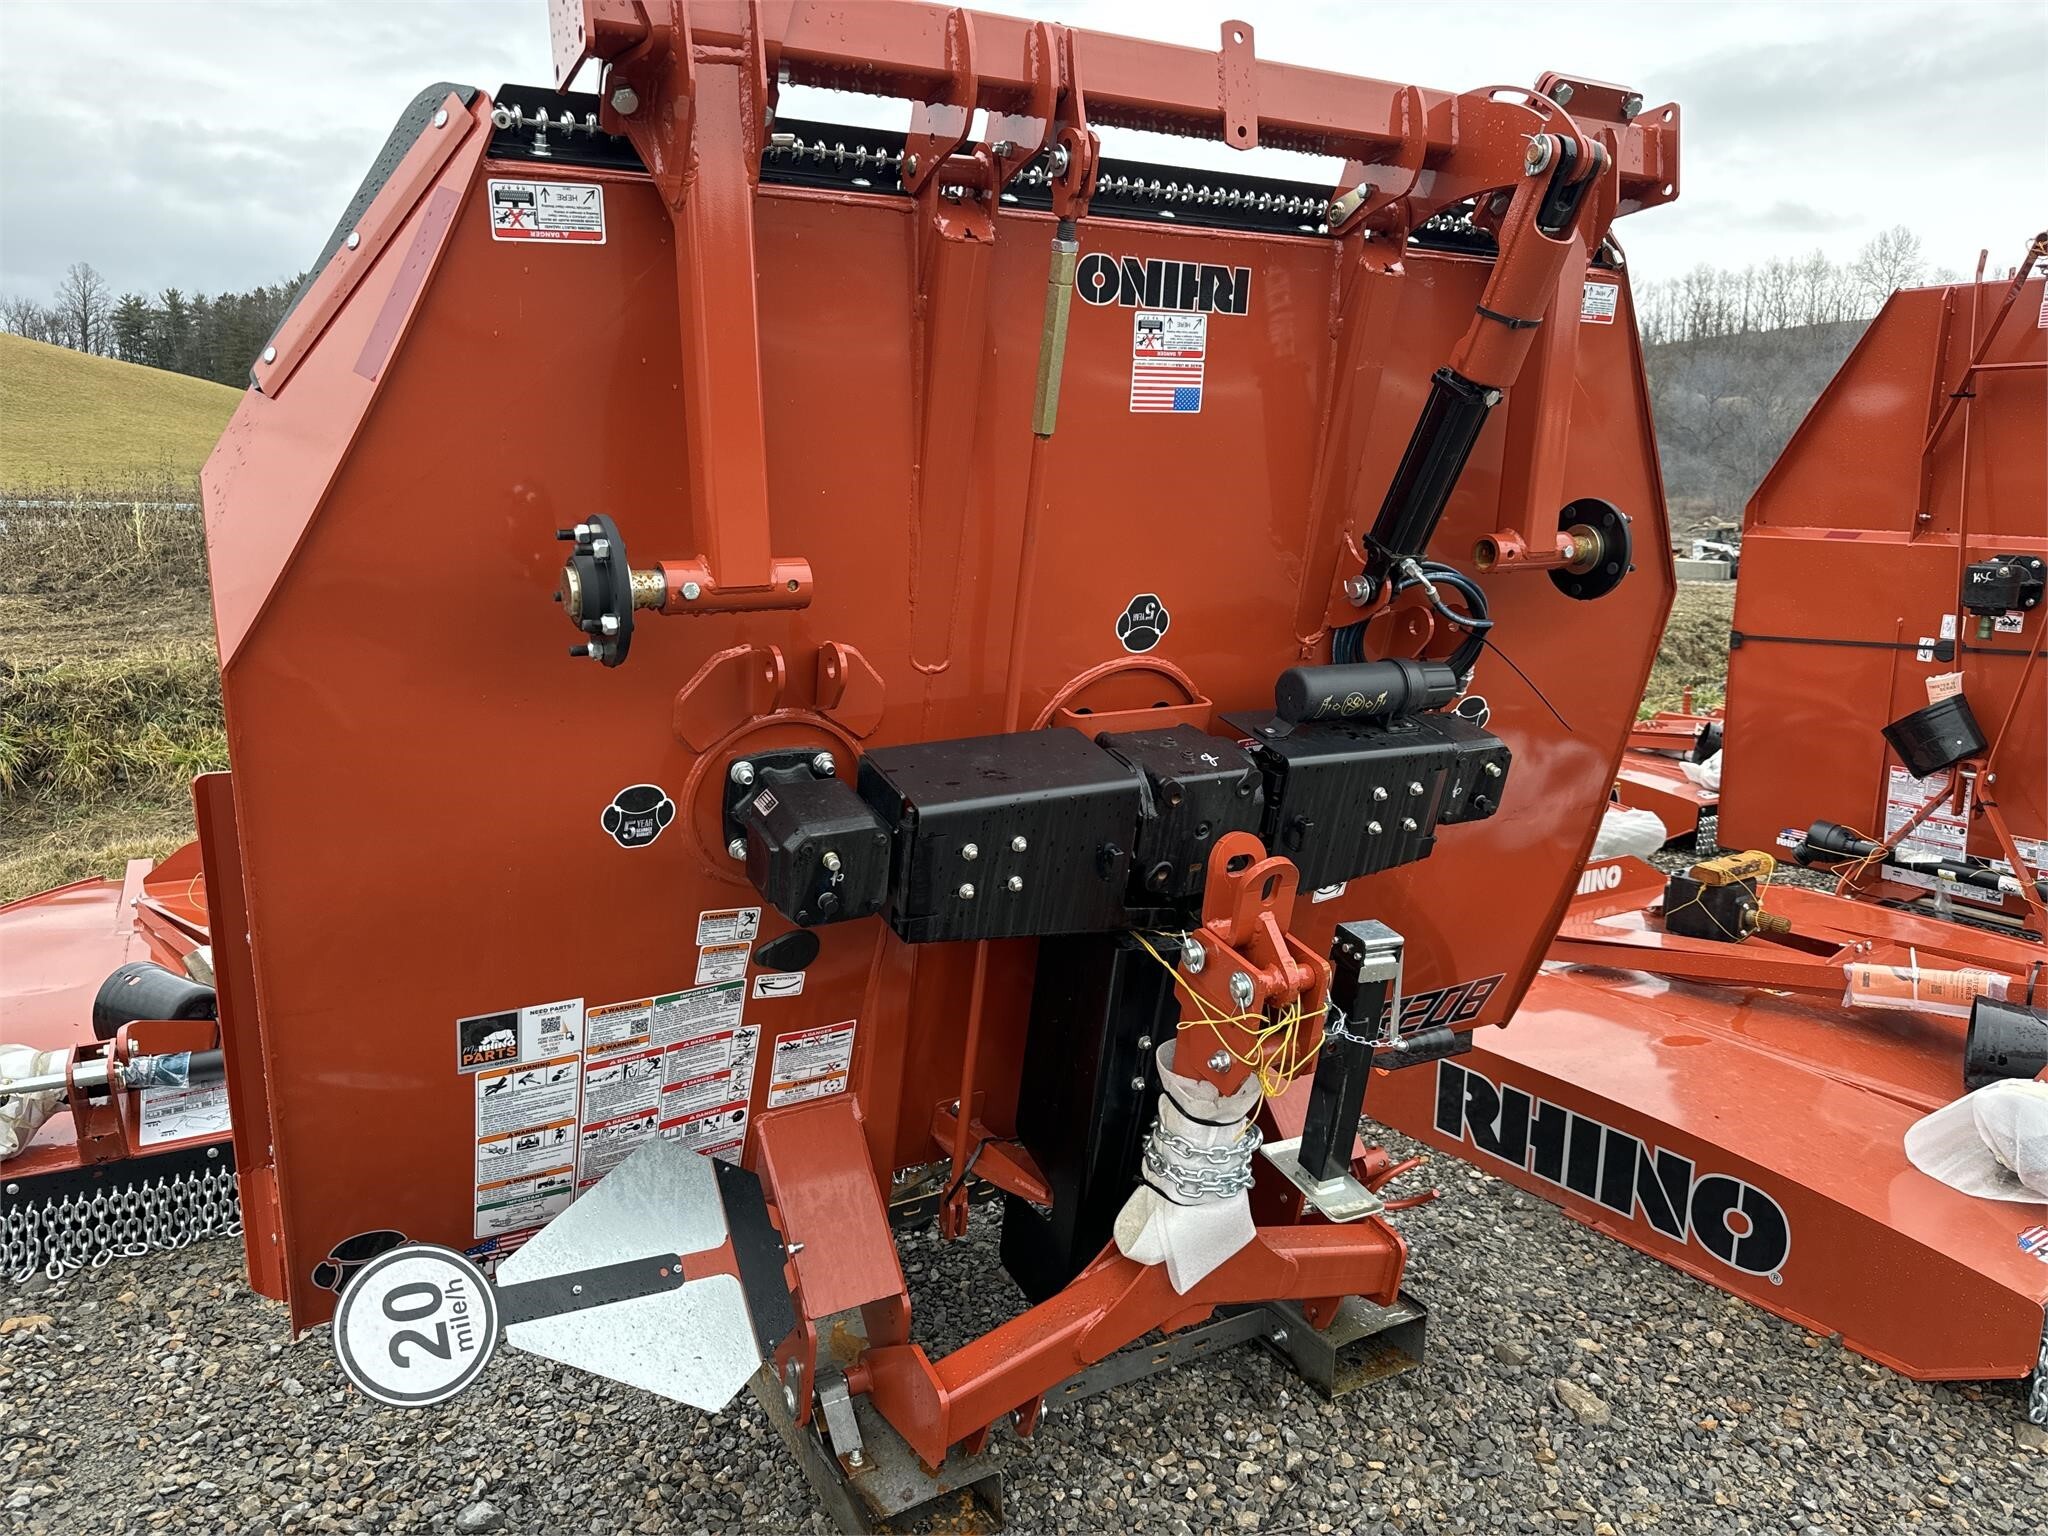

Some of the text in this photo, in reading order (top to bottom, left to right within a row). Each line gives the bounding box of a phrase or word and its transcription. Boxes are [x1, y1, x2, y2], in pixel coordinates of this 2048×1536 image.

[556, 194, 578, 202] HERE
[1076, 253, 1252, 316] RHINO
[623, 820, 636, 840] 5
[636, 818, 653, 828] YEAR
[1574, 865, 1622, 896] INO
[680, 987, 718, 999] IMPORTANT
[550, 1003, 576, 1012] PARTS?
[608, 1002, 642, 1013] WARNING
[478, 1038, 516, 1052] RHINO
[606, 1039, 639, 1050] WARNING
[688, 1036, 716, 1046] DANGER
[463, 1046, 516, 1066] PARTS
[617, 1053, 645, 1064] DANGER
[516, 1062, 550, 1072] WARNING
[688, 1074, 714, 1086] DANGER
[696, 1108, 722, 1119] DANGER
[612, 1114, 640, 1125] DANGER
[514, 1126, 548, 1136] WARNING
[1433, 1058, 1790, 1276] RHINO
[514, 1172, 546, 1183] WARNING
[506, 1194, 544, 1205] IMPORTANT
[445, 1278, 474, 1352] mile/h
[382, 1282, 452, 1368] 20
